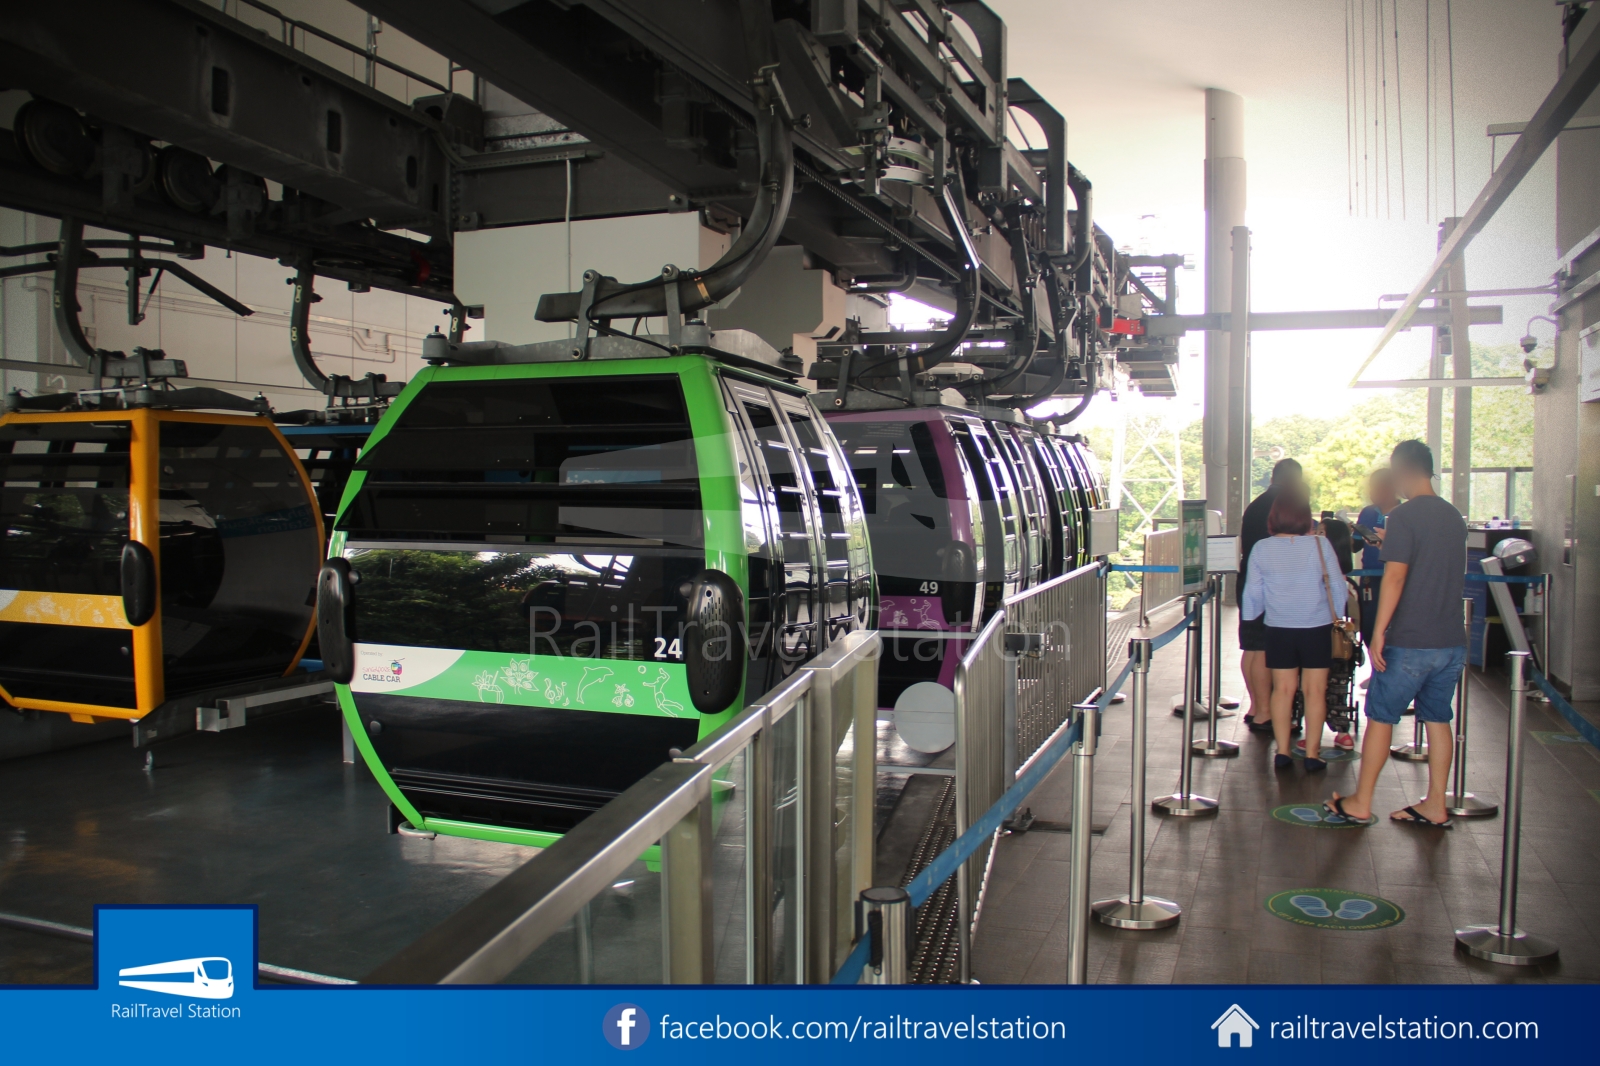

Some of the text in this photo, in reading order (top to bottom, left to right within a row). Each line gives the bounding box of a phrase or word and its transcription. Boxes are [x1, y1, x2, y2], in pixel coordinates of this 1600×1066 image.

[919, 581, 939, 594] 49
[654, 637, 683, 659] 24
[362, 673, 401, 683] CABLE CAR
